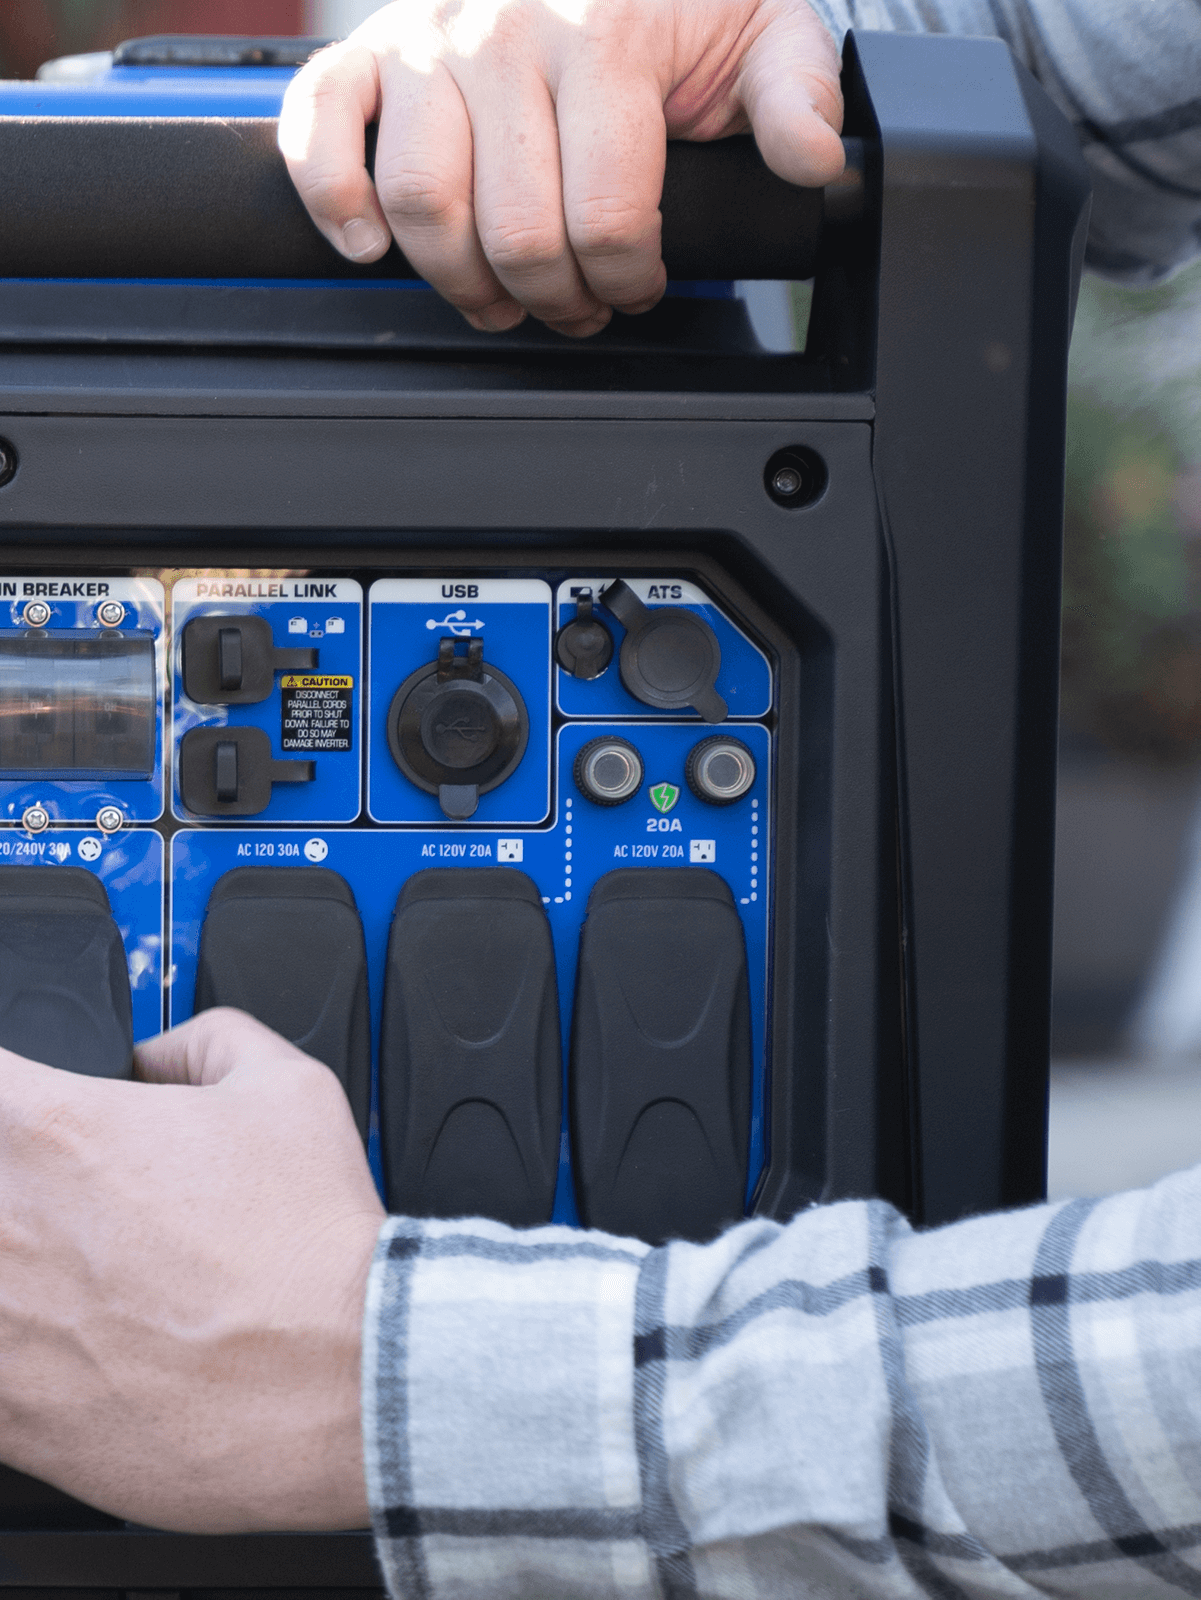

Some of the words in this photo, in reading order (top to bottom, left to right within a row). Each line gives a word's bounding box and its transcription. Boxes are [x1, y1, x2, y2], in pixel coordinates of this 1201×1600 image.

[23, 582, 110, 597] BREAKER
[197, 583, 288, 598] PARALLEL
[294, 583, 337, 598] LINK
[441, 584, 479, 598] USB
[647, 585, 682, 600] ATS
[302, 678, 348, 686] CAUTION
[295, 690, 339, 699] DISCONNECT
[288, 700, 321, 708] PARALLEL
[322, 700, 347, 709] CORDS
[291, 710, 313, 718] PRIOR
[313, 710, 323, 718] TO
[324, 710, 342, 718] SHUT
[311, 719, 338, 728] FAILURE
[340, 719, 349, 728] TO
[298, 730, 308, 738] DO
[310, 730, 319, 738] SO
[321, 730, 336, 738] MAY
[284, 739, 313, 747] DAMAGE
[646, 818, 682, 832] 20A
[49, 843, 71, 856] 30A
[237, 843, 251, 856] AC
[255, 843, 275, 856] 120
[278, 844, 300, 857] 30A
[421, 844, 436, 857] AC
[439, 844, 466, 857] 120V
[470, 845, 492, 858] 20A
[613, 845, 628, 858] AC
[632, 845, 658, 858] 120V
[661, 846, 684, 859] 20A
